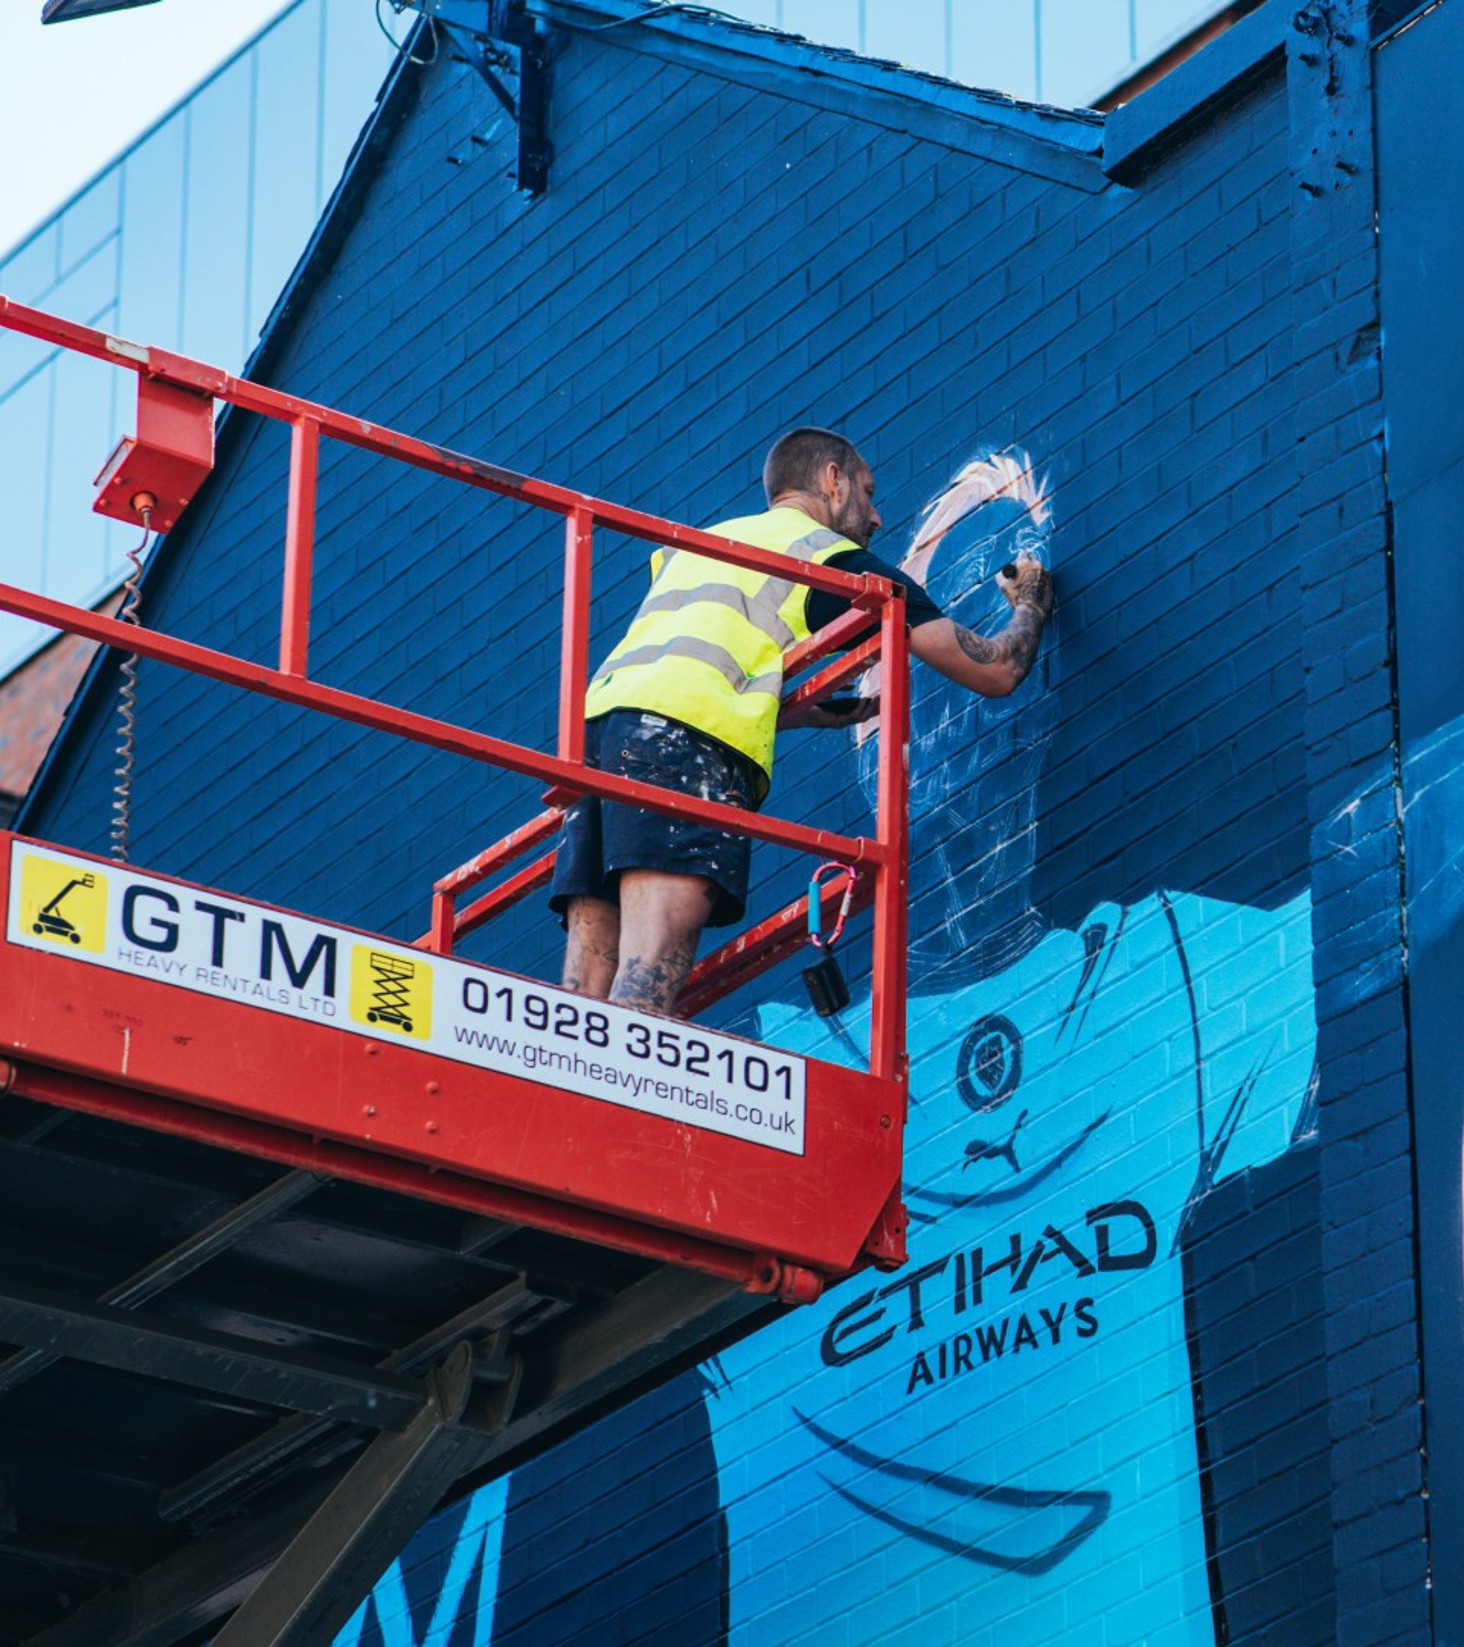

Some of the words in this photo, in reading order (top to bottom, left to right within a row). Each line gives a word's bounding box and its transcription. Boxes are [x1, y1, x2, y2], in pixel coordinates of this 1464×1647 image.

[118, 946, 187, 977] HEAVY
[196, 967, 291, 1006] RENTALS
[299, 994, 336, 1018] LTD
[122, 884, 338, 998] GTM
[454, 1025, 796, 1135] www.gtmheavyrentals.co.uk
[463, 976, 610, 1048] 01928
[626, 1022, 793, 1100] 352101
[820, 1199, 1157, 1367] ETIHAD
[906, 1297, 1099, 1395] AIRWAYS
